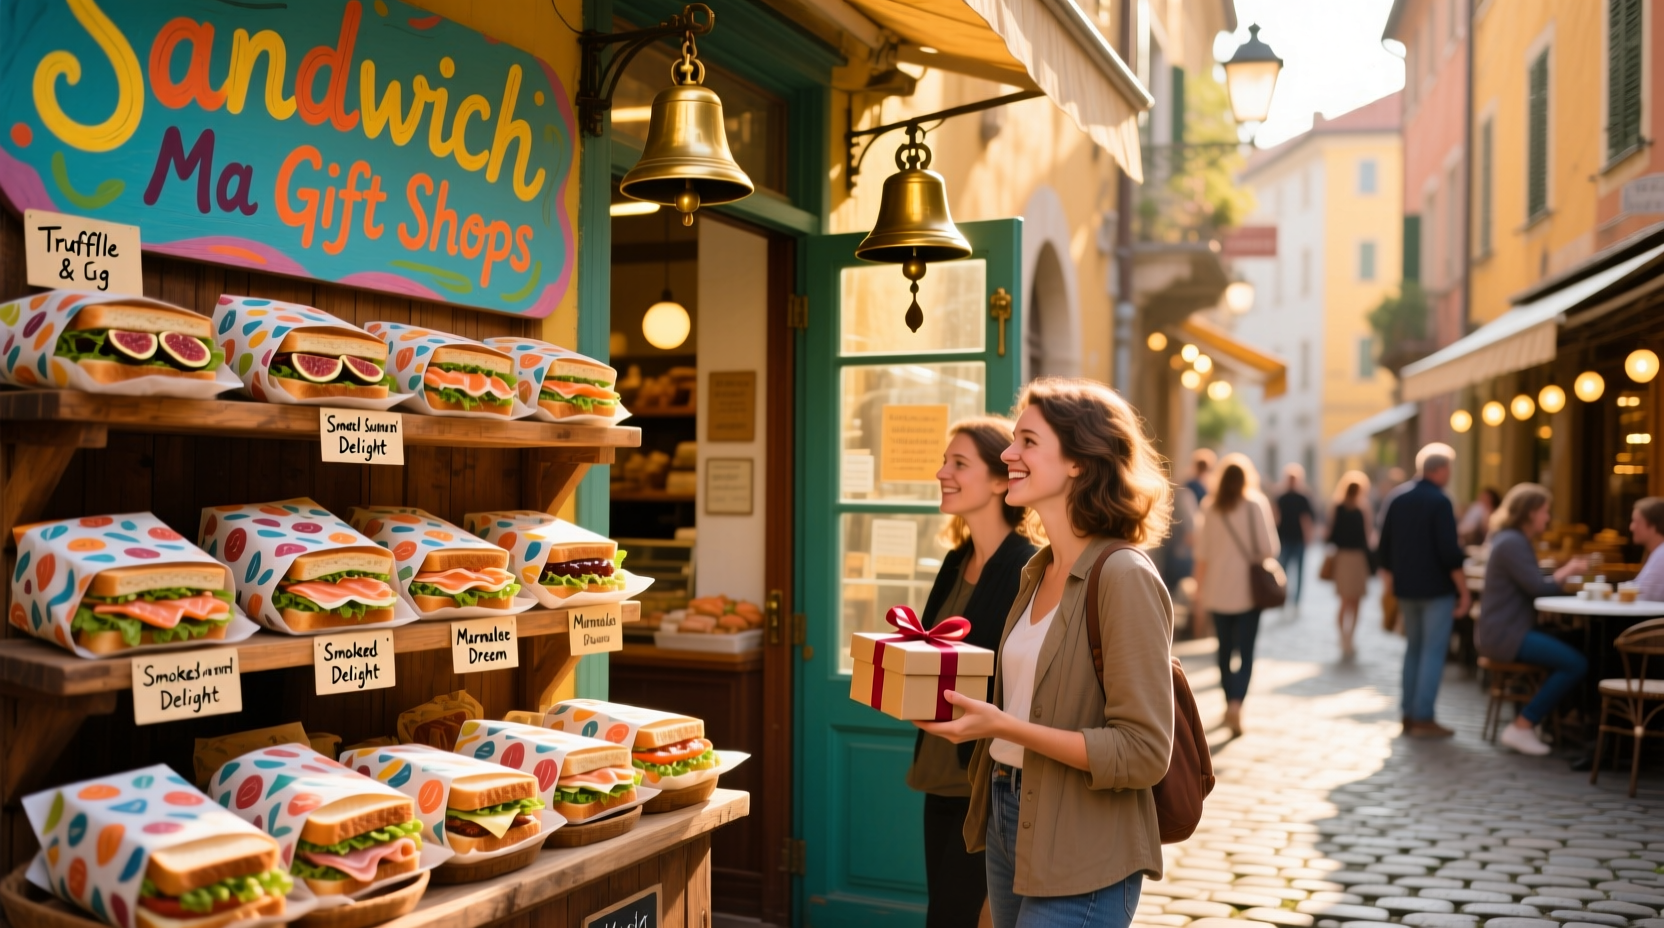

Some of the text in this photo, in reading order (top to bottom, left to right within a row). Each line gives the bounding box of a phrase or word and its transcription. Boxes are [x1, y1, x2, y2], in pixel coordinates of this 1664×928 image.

[33, 0, 546, 201] Sandwich
[143, 126, 534, 288] Ma Gift Shops
[59, 258, 74, 281] &
[339, 436, 387, 462] Delight
[324, 639, 378, 661] Smoked
[332, 662, 380, 689] Delight
[161, 686, 220, 713] Delight
